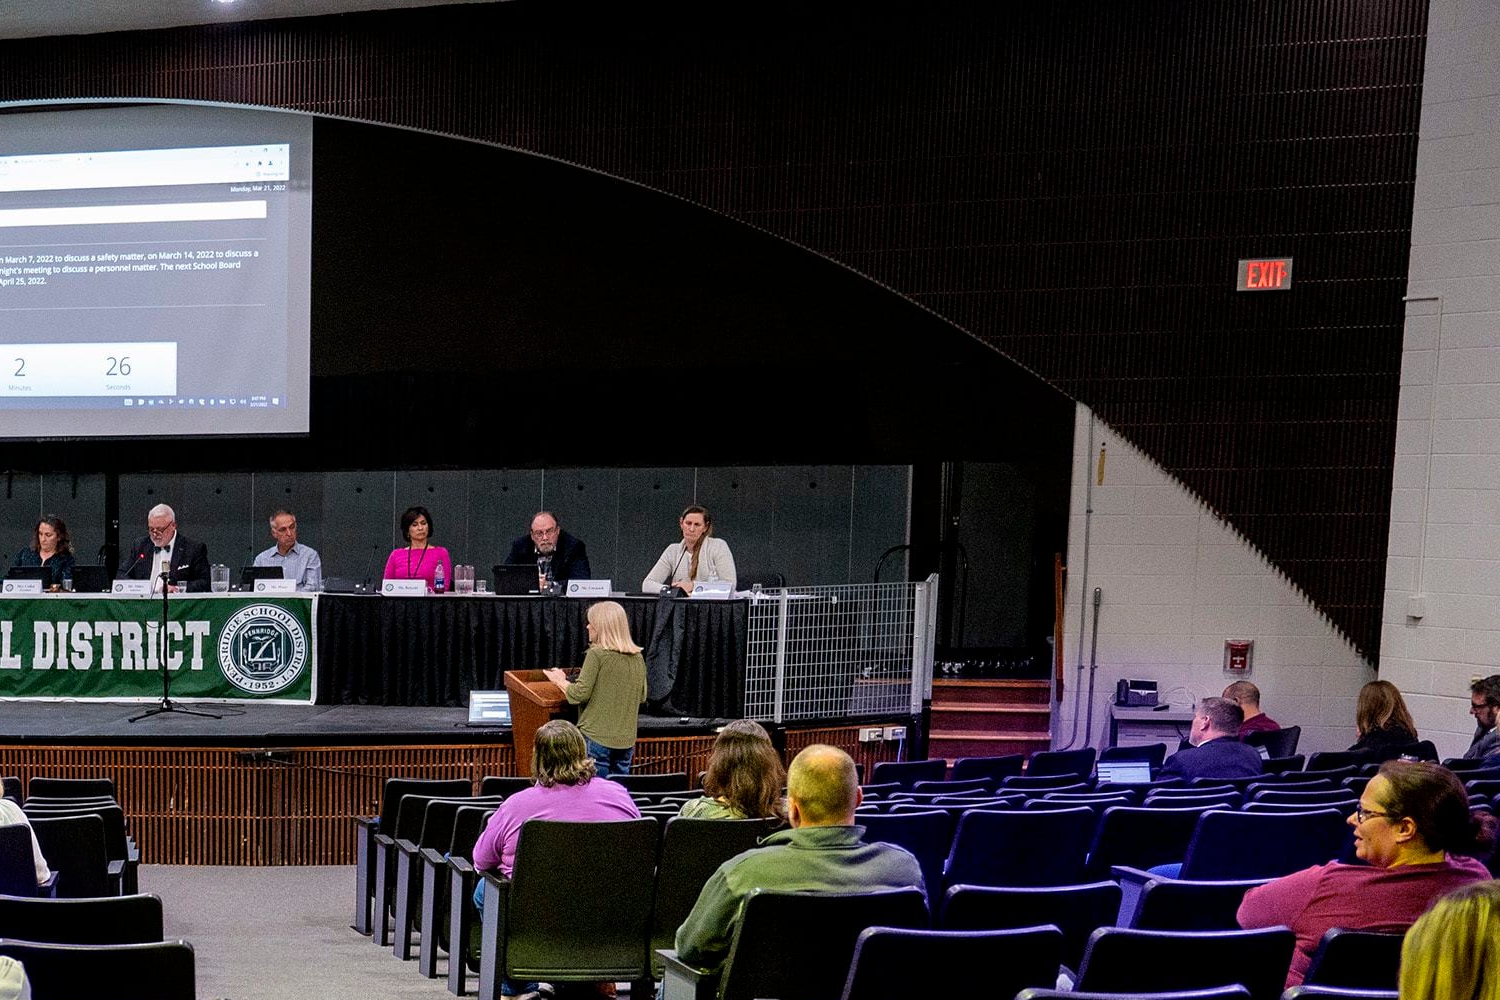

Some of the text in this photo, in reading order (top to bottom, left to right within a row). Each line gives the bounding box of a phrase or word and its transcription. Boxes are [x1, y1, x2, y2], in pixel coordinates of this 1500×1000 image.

[5, 256, 27, 264] March
[28, 256, 35, 264] 7,
[36, 255, 53, 263] 2022
[64, 254, 89, 262] discuss
[97, 253, 118, 263] safety
[120, 253, 146, 261] matter,
[159, 252, 182, 260] March
[184, 252, 195, 260] 14,
[196, 251, 214, 259] 2022
[225, 250, 251, 258] discuss
[23, 266, 52, 275] meeting
[62, 265, 87, 273] discuss
[95, 264, 131, 274] personnel
[160, 263, 173, 271] The
[193, 262, 217, 270] School
[219, 261, 240, 269] Board
[1247, 261, 1284, 288] EXIT
[14, 358, 26, 377] 2
[105, 356, 131, 376] 26
[105, 383, 131, 392] Seconds
[244, 628, 278, 638] PENNRIDGE
[32, 621, 210, 670] DISTRICT
[221, 608, 304, 683] PENNRIDGE SCHOOL DISTRICT
[249, 681, 275, 689] 1952
